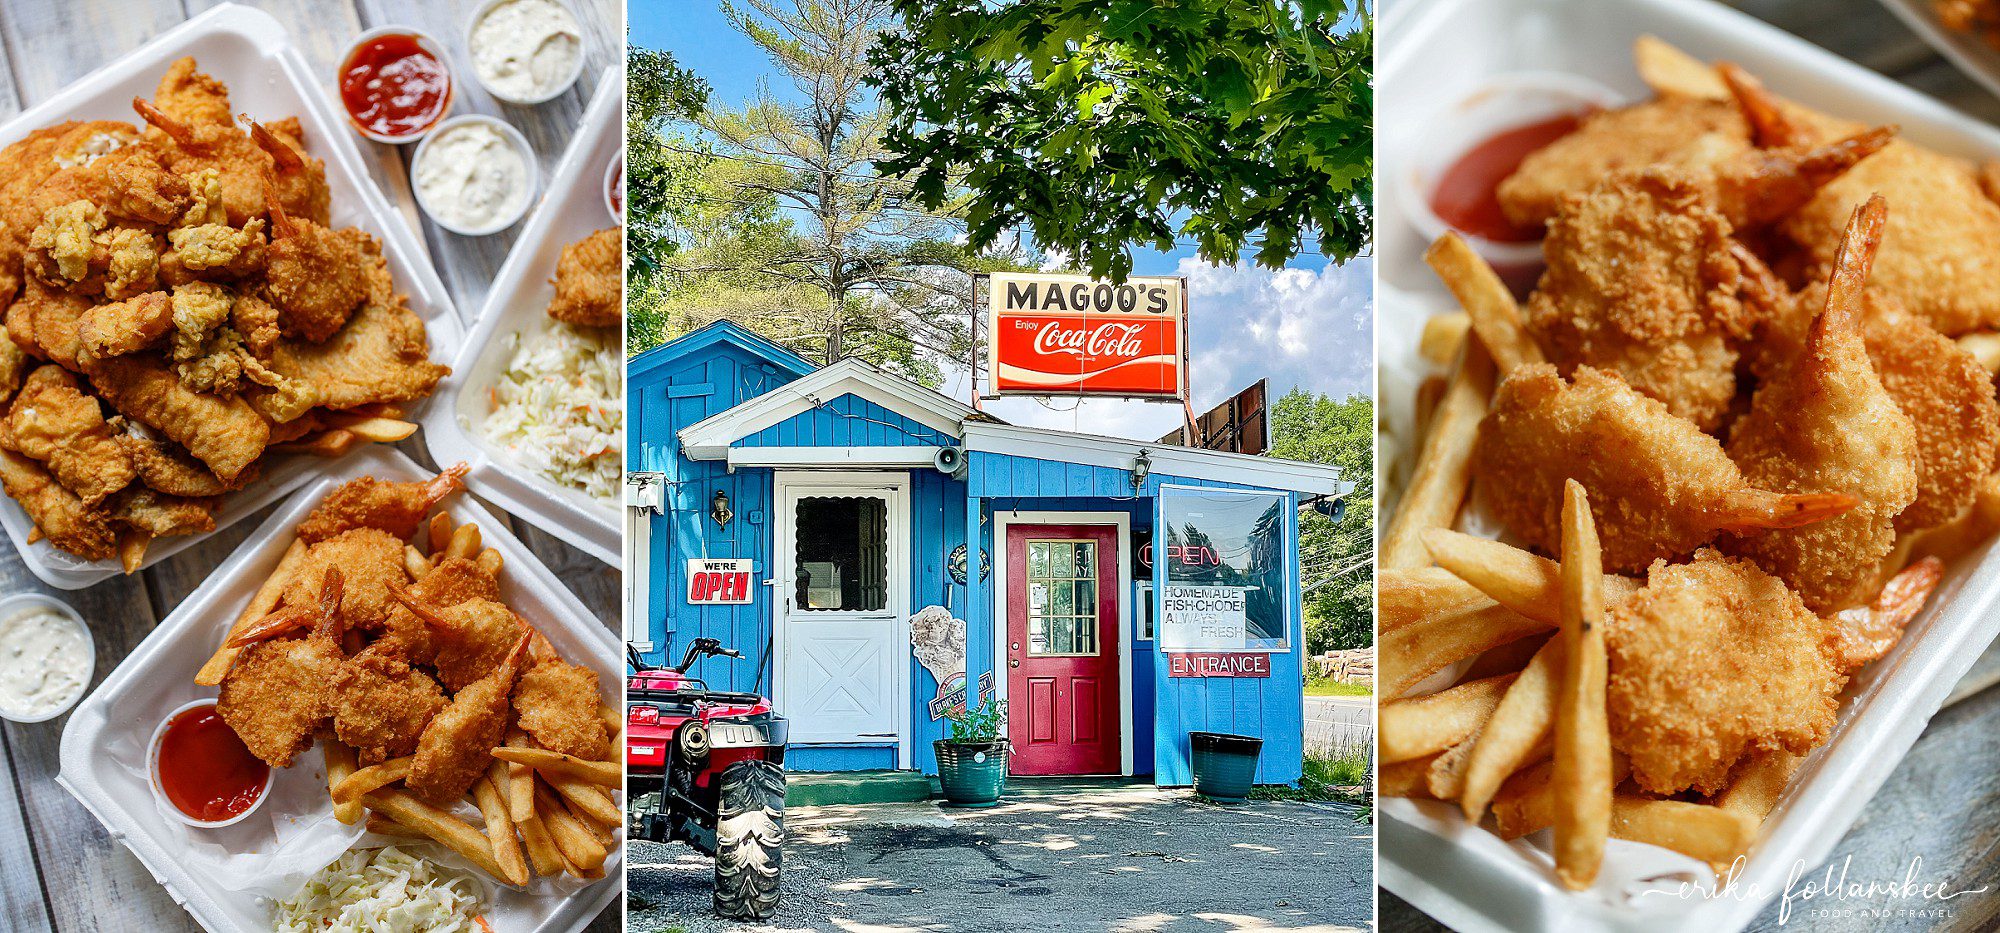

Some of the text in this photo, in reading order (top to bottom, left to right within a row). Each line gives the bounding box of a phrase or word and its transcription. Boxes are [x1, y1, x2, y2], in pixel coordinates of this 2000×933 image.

[1006, 281, 1169, 314] MAGOO'S
[1015, 320, 1039, 331] Enjoy
[1033, 320, 1147, 357] Coca-Cola
[704, 562, 737, 571] WE'RE
[690, 571, 749, 601] OPEN
[1164, 586, 1239, 599] HOMEMADE
[1165, 612, 1218, 624] ALWAYS
[1200, 626, 1243, 638] FRESH
[1173, 656, 1267, 673] ENTRANCE
